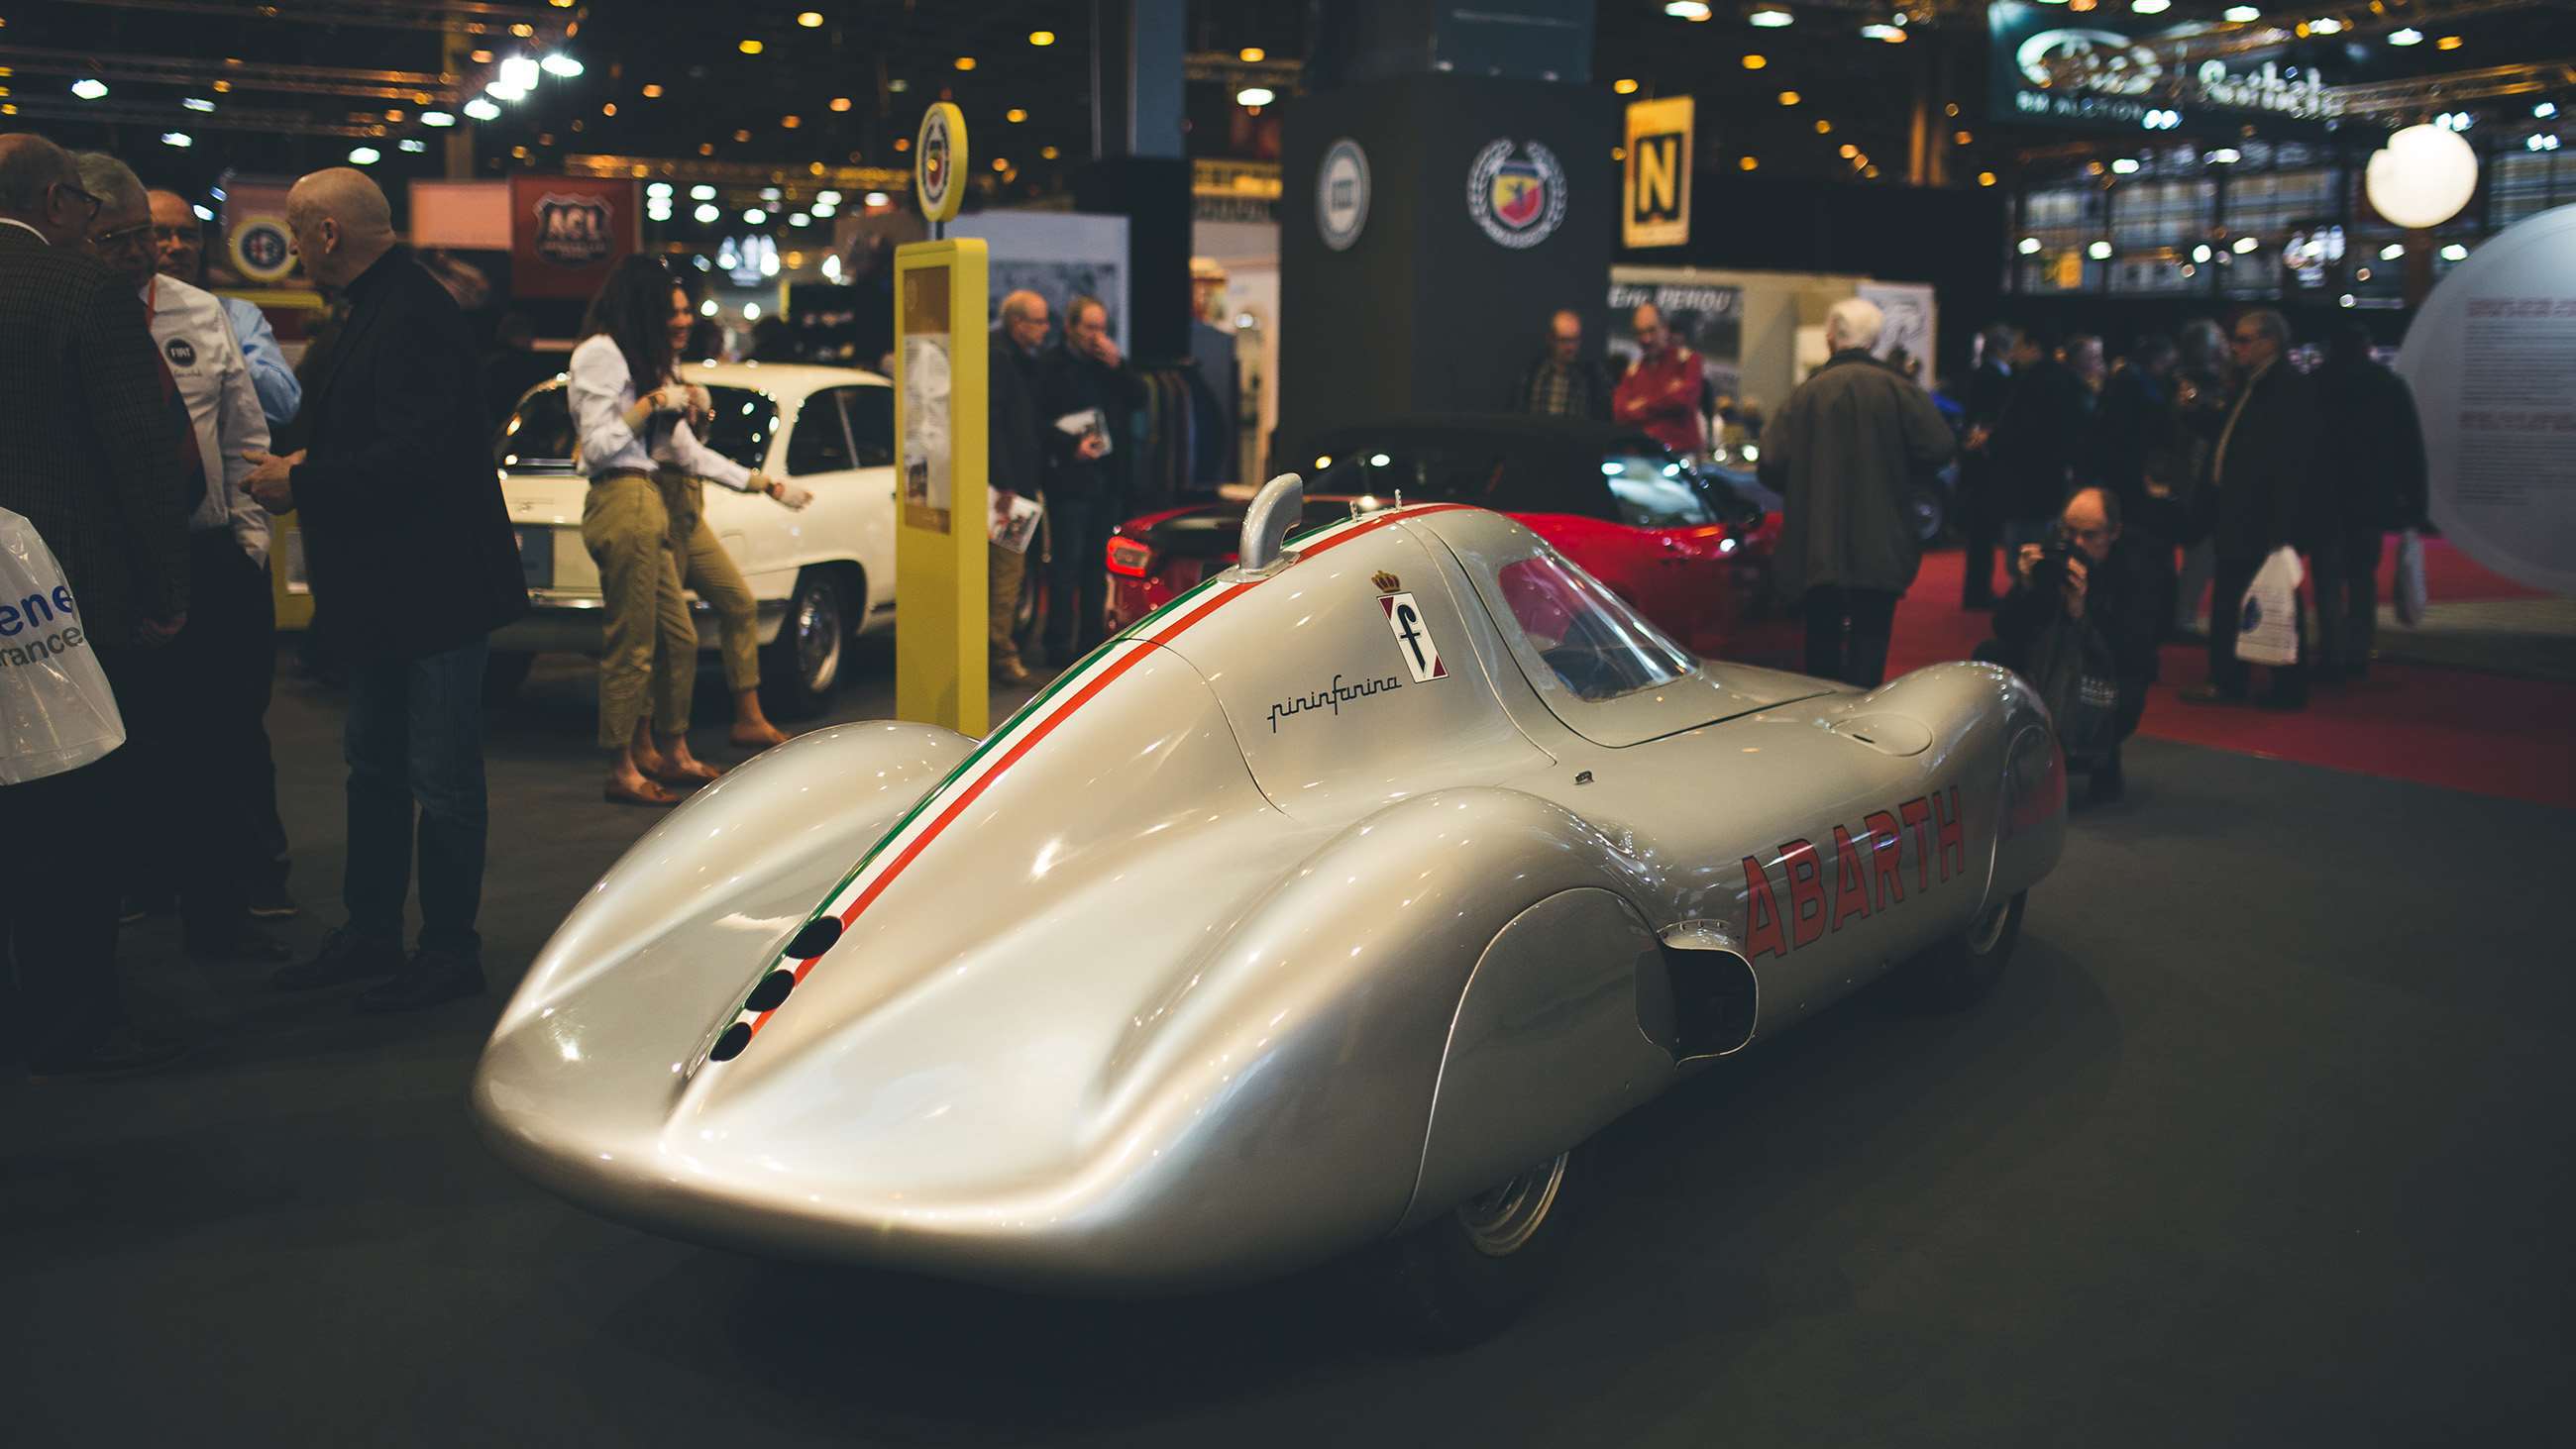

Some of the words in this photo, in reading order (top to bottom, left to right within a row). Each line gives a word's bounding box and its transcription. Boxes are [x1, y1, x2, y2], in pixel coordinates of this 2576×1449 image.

[1638, 137, 1677, 213] N
[1267, 673, 1403, 733] pininfarina
[1742, 784, 1965, 967] ABARTH
